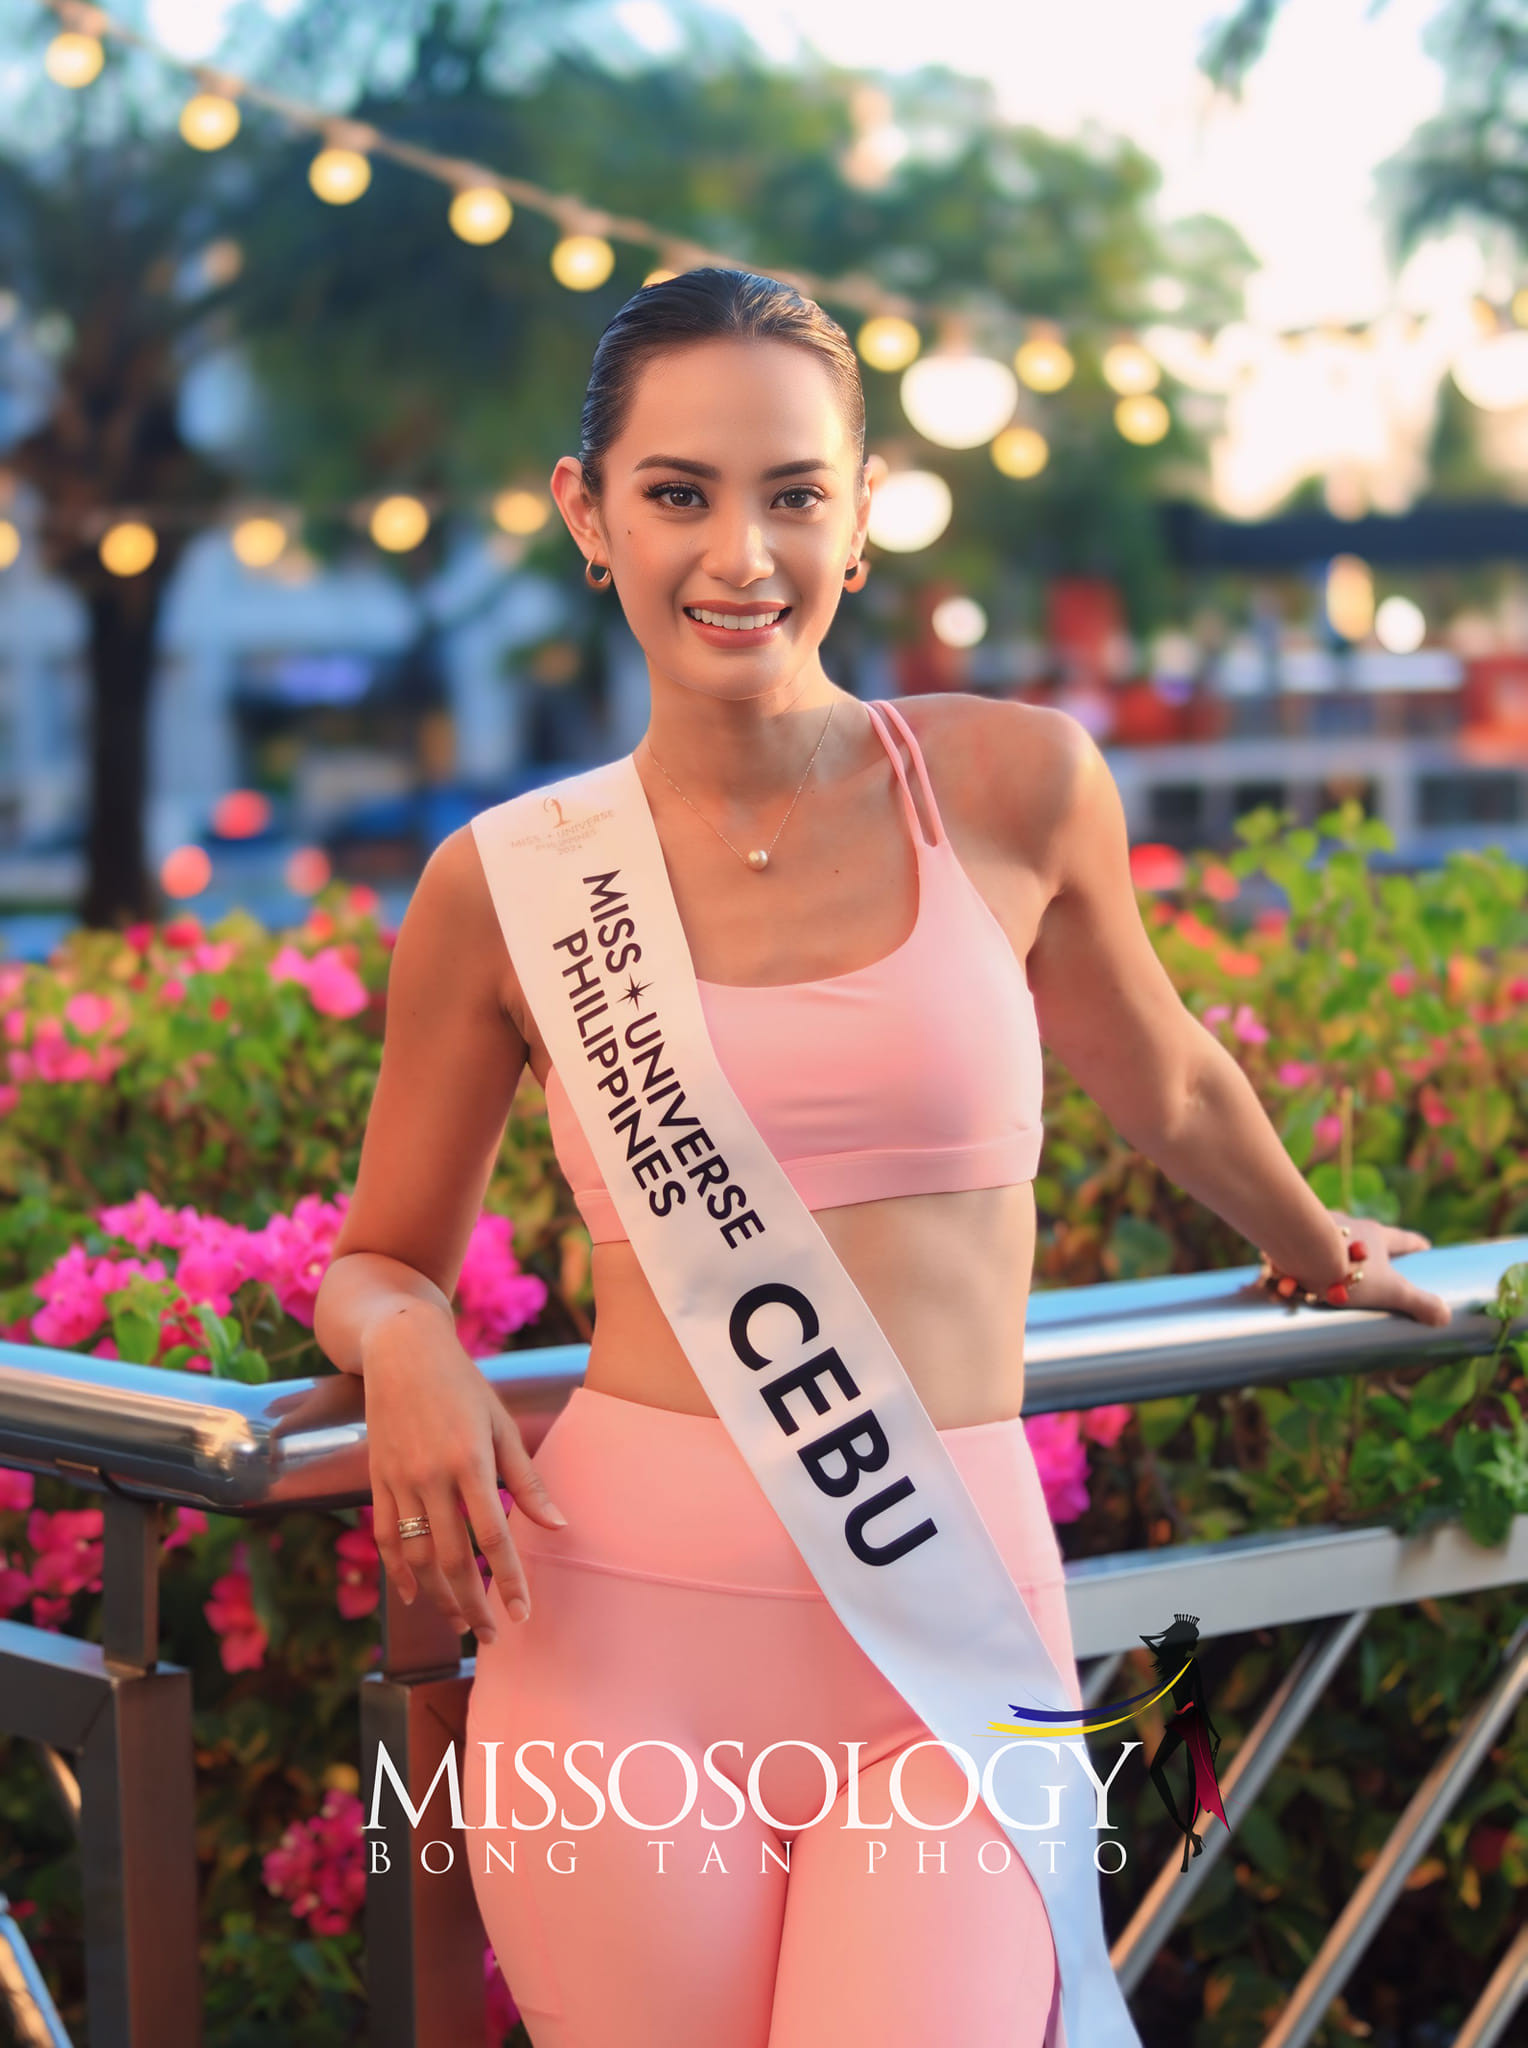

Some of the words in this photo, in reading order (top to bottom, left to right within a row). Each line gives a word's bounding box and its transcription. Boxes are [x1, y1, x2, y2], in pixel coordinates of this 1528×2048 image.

[556, 809, 615, 838] UNIVERSE
[552, 928, 688, 1218] PHILIPPINES
[582, 869, 642, 974] MISS
[624, 1011, 766, 1250] UNIVERSE
[729, 1283, 938, 1567] CEBU
